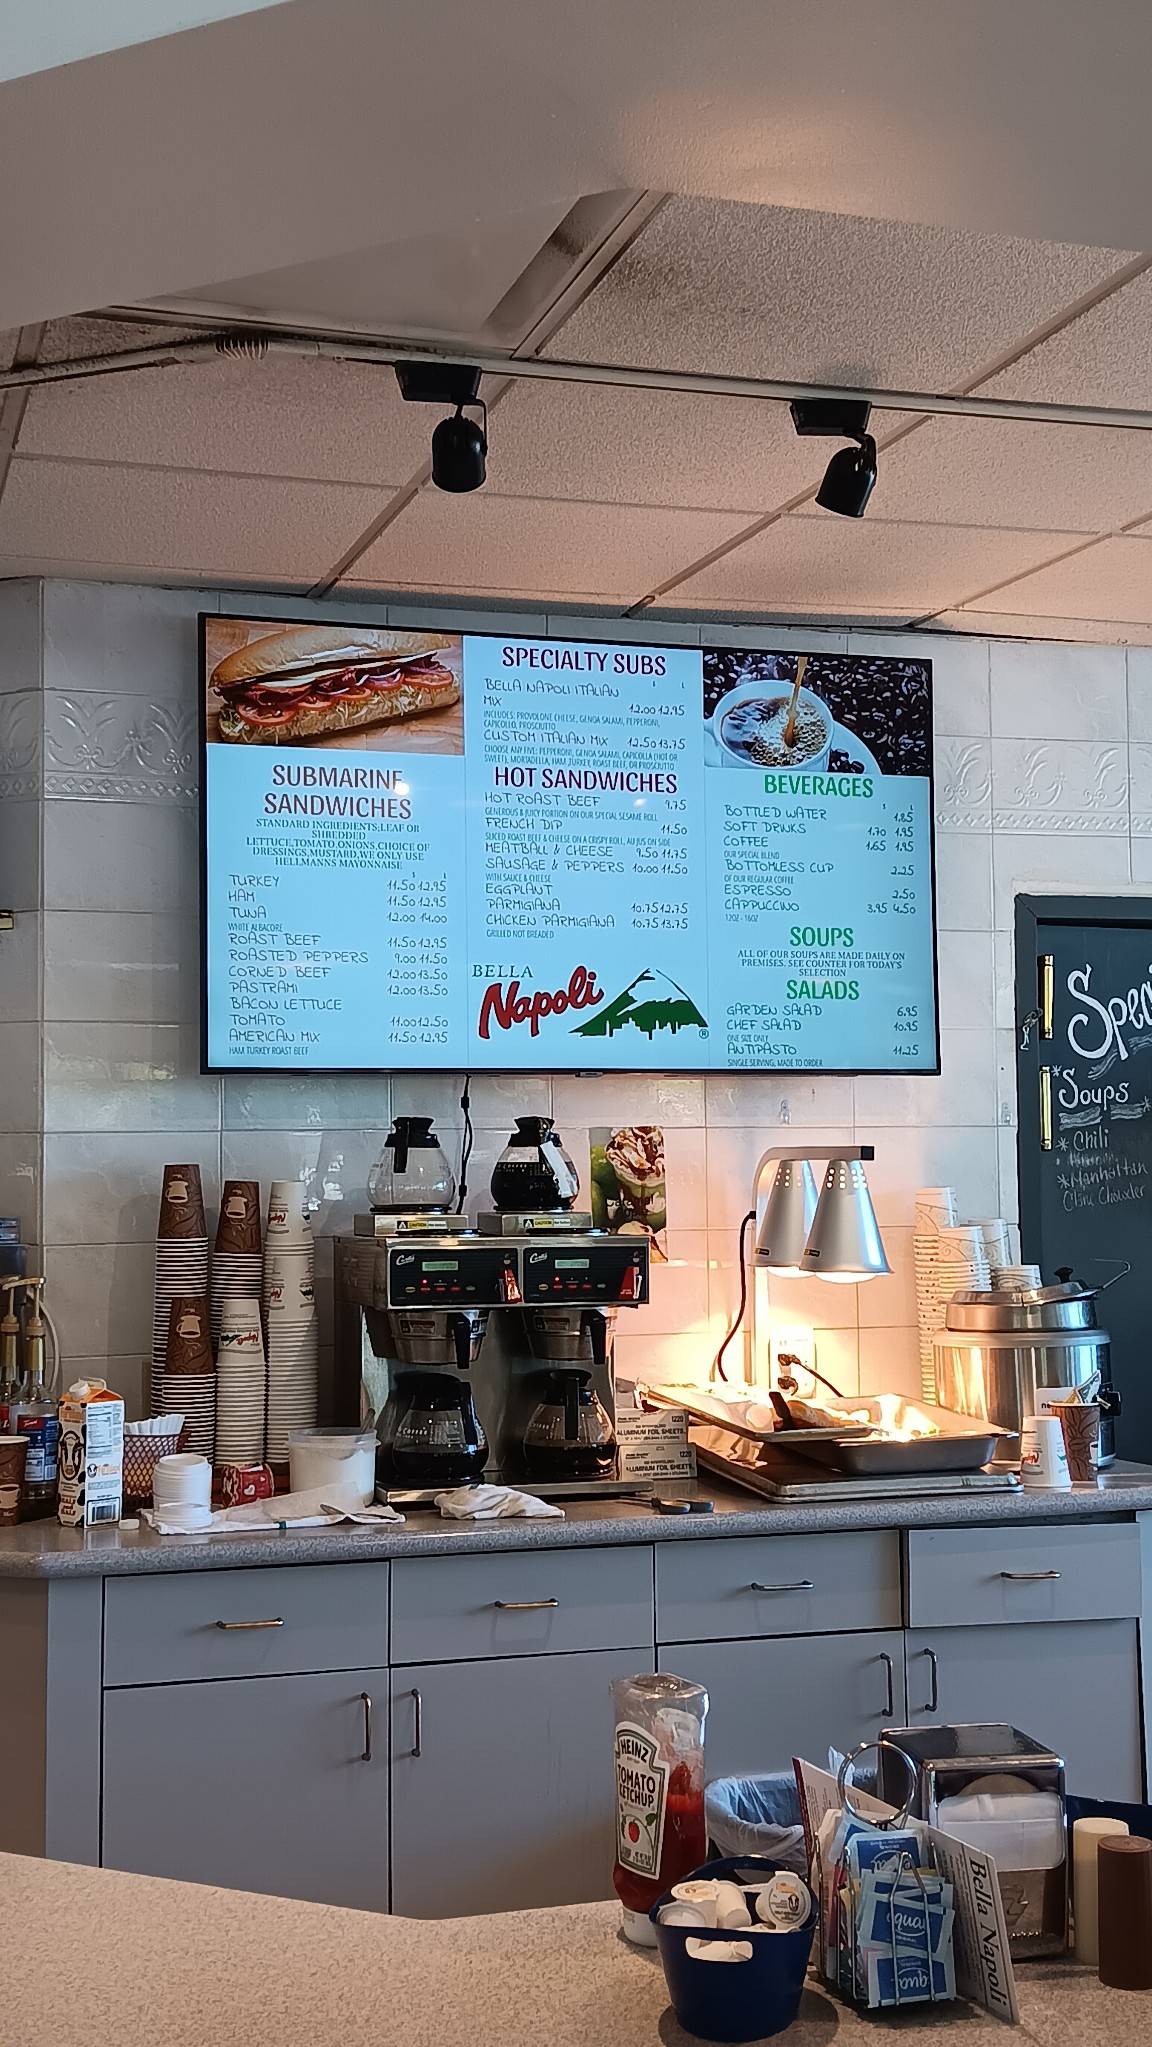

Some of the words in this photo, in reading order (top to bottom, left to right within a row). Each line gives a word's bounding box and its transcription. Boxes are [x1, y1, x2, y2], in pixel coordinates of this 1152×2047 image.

[502, 647, 608, 672] SPECIALTY
[613, 653, 666, 676] SUBS
[485, 678, 521, 692] BELLA
[526, 680, 570, 695] NAPOLI
[575, 683, 619, 697] ITALIAN
[484, 695, 501, 706] MIX
[628, 703, 656, 715] 12.00
[484, 729, 535, 742] CUSTOM
[541, 732, 585, 745] ITALIAN
[591, 735, 608, 746] MIX
[272, 764, 403, 791] SUBMARINE
[495, 766, 537, 787] HOT
[542, 768, 677, 794] SANDWICHES
[764, 775, 873, 798] BEVERAGES
[264, 793, 411, 819] SANDWICHES
[485, 792, 512, 804] HOT
[516, 792, 561, 806] ROAST
[568, 794, 600, 807] BEEF
[724, 805, 781, 818] BOTTLED
[786, 806, 827, 820] WATER
[256, 818, 309, 828] STANDARD
[407, 825, 420, 833] OR
[485, 817, 534, 829] FRENCH
[542, 819, 563, 830] DIP
[724, 821, 757, 832] SOFT
[763, 822, 806, 833] DRINKS
[312, 830, 366, 840] SHREDDED
[724, 836, 768, 847] COFFEE
[417, 843, 430, 852] OF
[486, 842, 548, 855] MEATBALL
[554, 844, 560, 856] &
[566, 845, 613, 857] CHEESE
[377, 851, 403, 860] ONLY
[405, 853, 424, 861] USE
[275, 857, 337, 867] HELLMANNS
[339, 859, 403, 870] MAYONNAISE
[486, 856, 545, 870] SAUSAGE
[552, 859, 558, 870] &
[564, 860, 624, 873] PEPPERS
[725, 859, 805, 872] BOTTOMLESS
[810, 863, 834, 873] CUP
[229, 874, 279, 888] TURKEY
[228, 888, 255, 902] HAM
[486, 883, 553, 895] EGGPLANT
[725, 884, 791, 896] ESPRESSO
[486, 897, 560, 911] PARMIGIANA
[725, 897, 799, 912] CAPPUCCINO
[229, 906, 267, 918] TUNA
[486, 914, 536, 926] CHICKEN
[542, 915, 615, 928] PARMIGIANA
[229, 932, 278, 945] ROAST
[283, 934, 321, 946] BEEF
[790, 927, 854, 947] SOUPS
[229, 948, 297, 962] ROASTED
[303, 951, 369, 963] PEPPERS
[738, 950, 755, 958] ALL
[756, 950, 768, 958] OF
[790, 951, 818, 959] SOUPS
[820, 951, 836, 959] ARE
[838, 952, 863, 960] MADE
[866, 952, 890, 960] DAILY
[892, 952, 905, 960] ON
[472, 964, 534, 978] BELLA
[806, 960, 847, 968] COUNTER
[849, 960, 866, 968] FOR
[229, 966, 287, 977] CORNED
[294, 966, 332, 978] BEEF
[799, 969, 846, 977] SELECTION
[229, 980, 298, 994] PASTRAMI
[786, 980, 859, 1000] SALADS
[230, 997, 279, 1010] BACON
[284, 998, 343, 1010] LETTUCE
[478, 965, 604, 1040] Napoli
[727, 1003, 777, 1016] GARDEN
[782, 1003, 822, 1016] SALAD
[1067, 963, 1152, 1060] Spec
[229, 1013, 286, 1026] TOMATO
[727, 1019, 757, 1031] CHEF
[762, 1018, 801, 1031] SALAD
[229, 1029, 295, 1042] AMERICAN
[301, 1031, 321, 1043] MIX
[728, 1042, 797, 1055] ANTIPASTO
[1059, 1068, 1129, 1111] Soups
[1074, 1125, 1108, 1151] Chili
[621, 1739, 649, 1763] HEINZ
[618, 1764, 655, 1793] TOMATO
[969, 1857, 992, 1916] Bella
[980, 1923, 1007, 2006] Napoli
